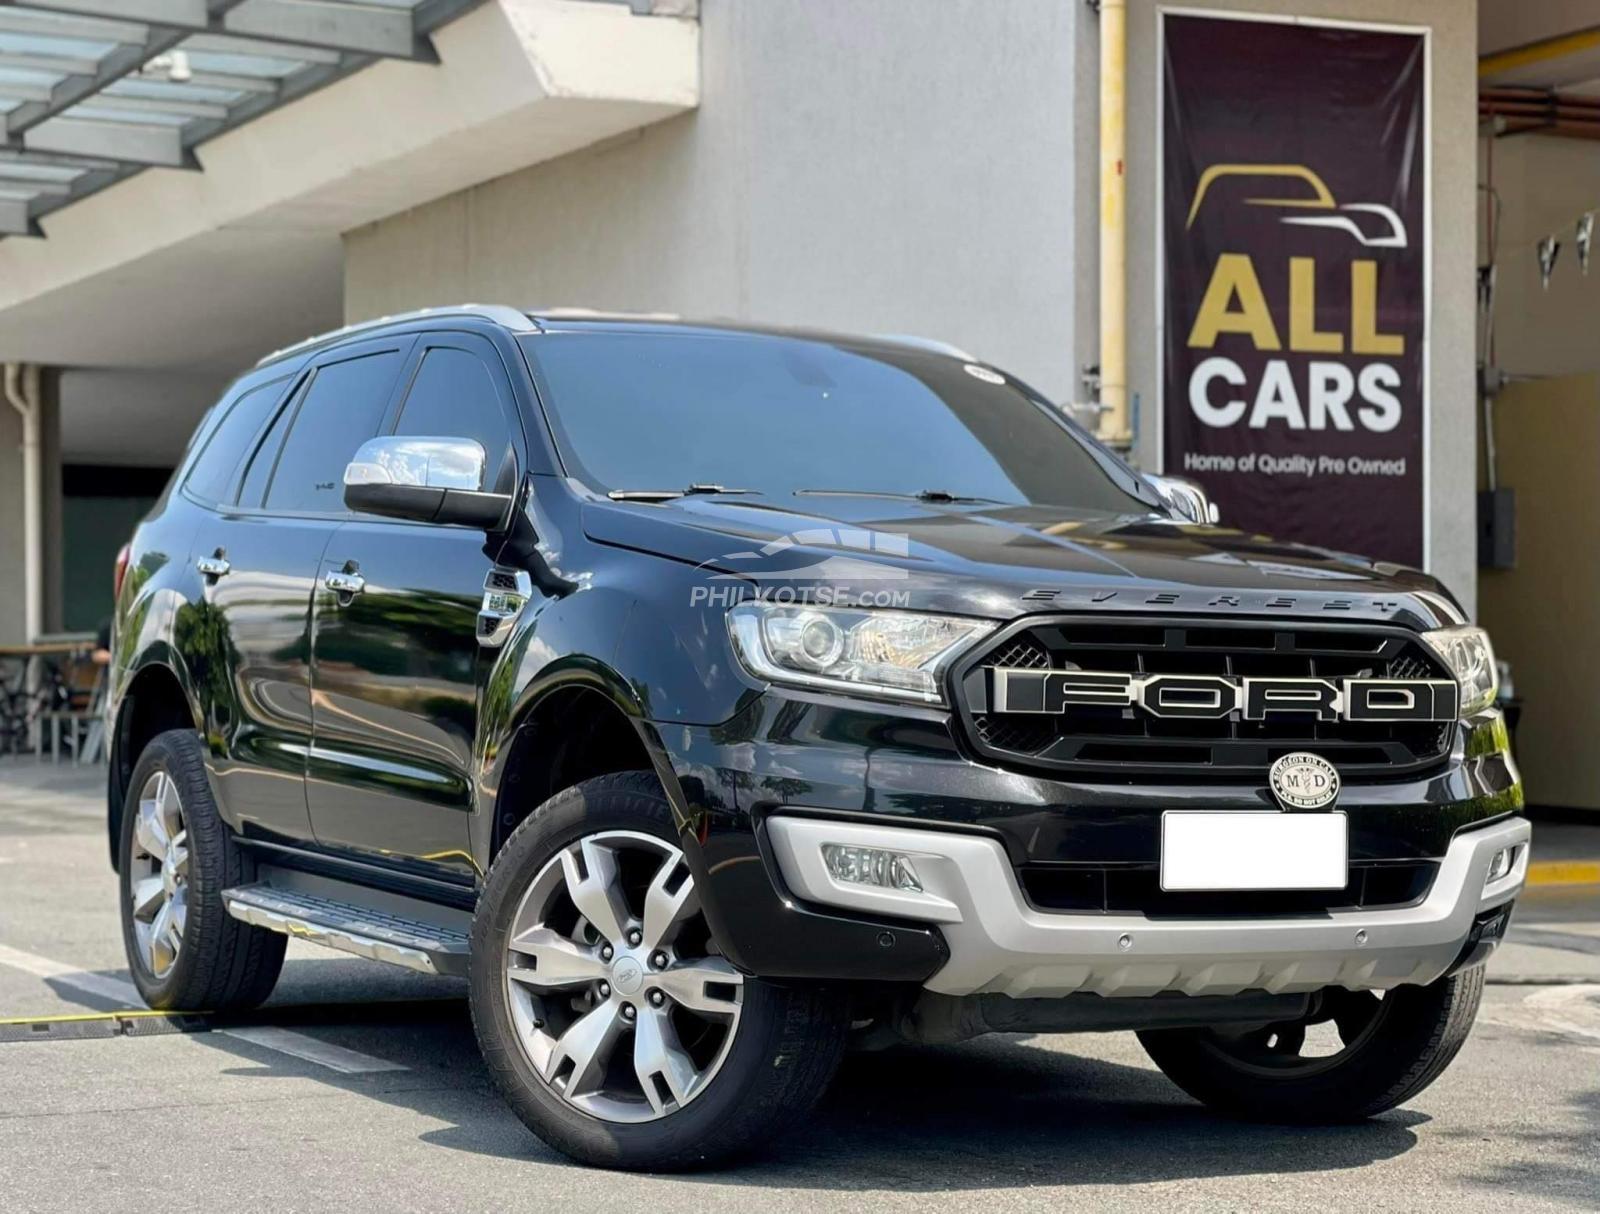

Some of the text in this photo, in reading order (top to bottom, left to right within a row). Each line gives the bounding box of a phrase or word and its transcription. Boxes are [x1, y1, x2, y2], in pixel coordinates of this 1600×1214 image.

[1187, 253, 1405, 355] ALL
[1188, 357, 1402, 432] CARS
[1184, 452, 1406, 477] Home of Quality Pre Owned
[1022, 590, 1397, 612] EVEREST
[995, 667, 1457, 722] FORD
[1286, 774, 1326, 788] M D
